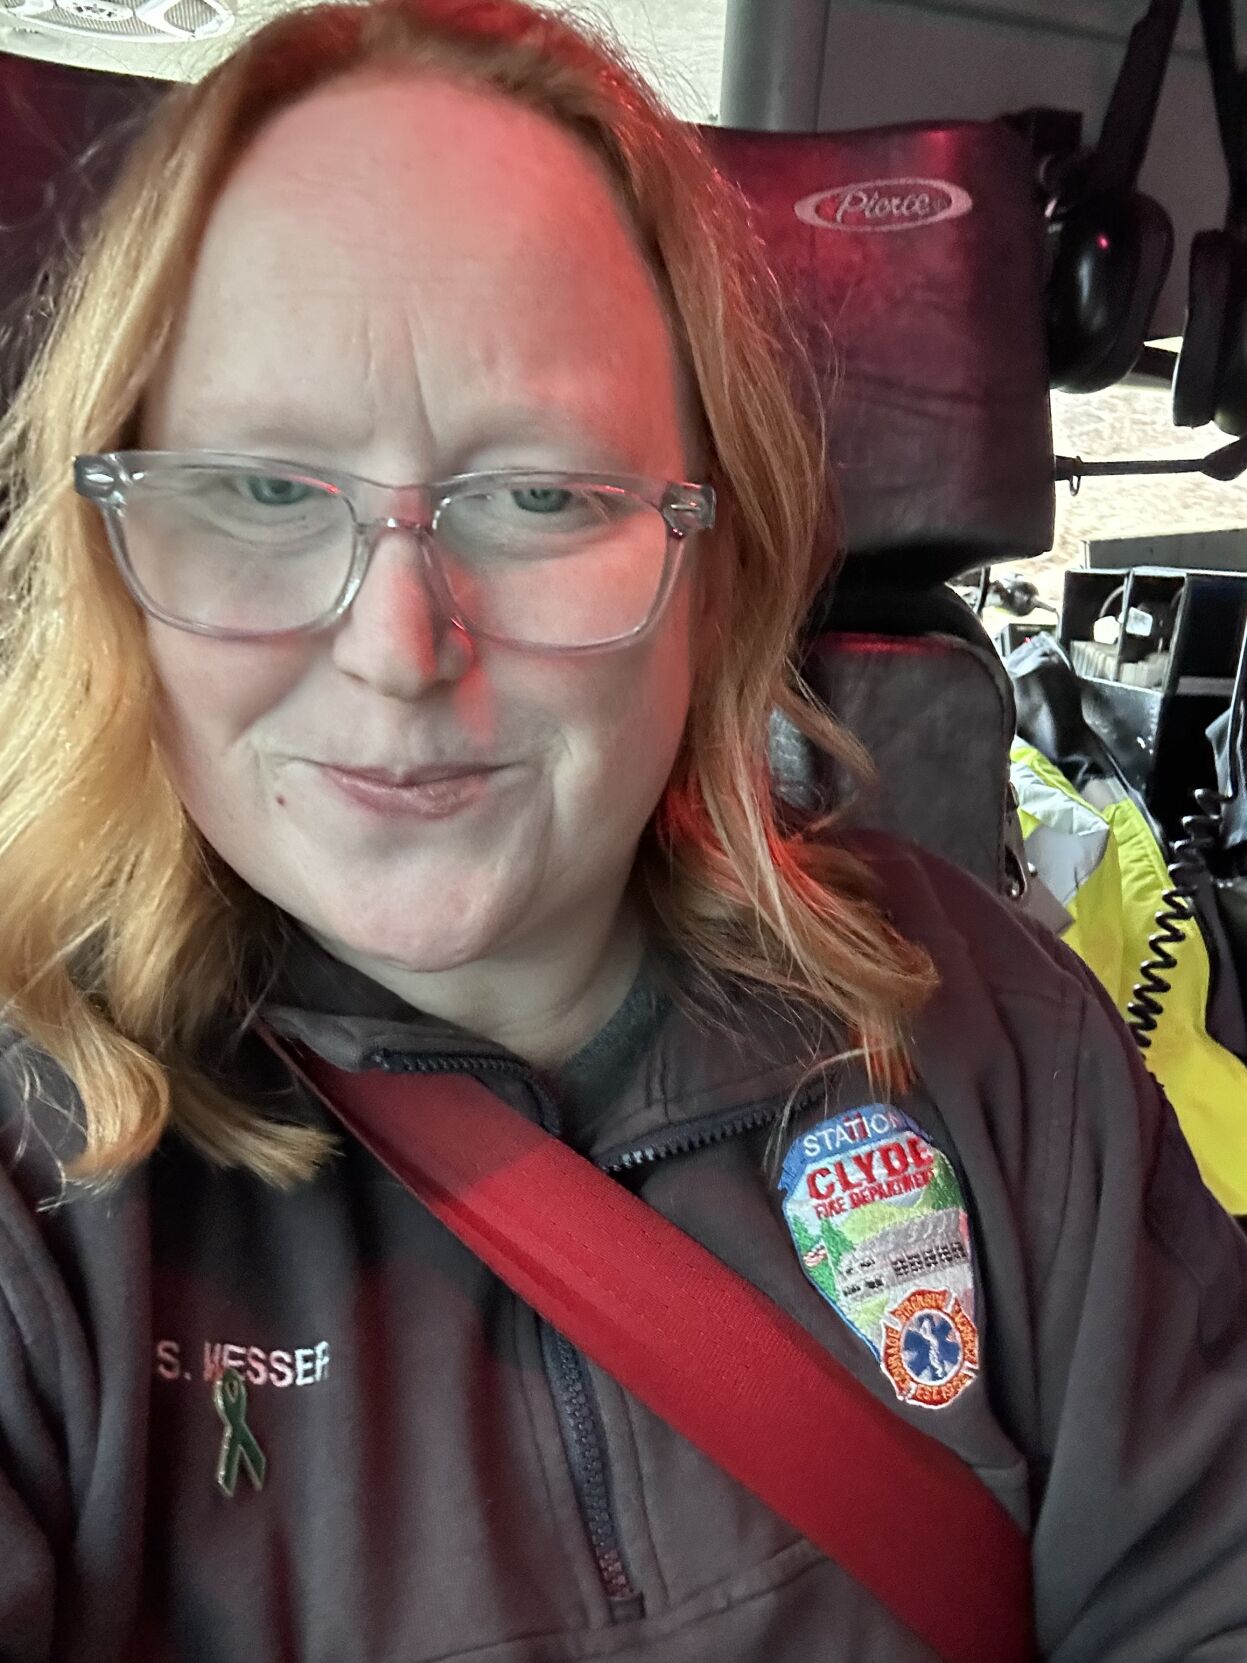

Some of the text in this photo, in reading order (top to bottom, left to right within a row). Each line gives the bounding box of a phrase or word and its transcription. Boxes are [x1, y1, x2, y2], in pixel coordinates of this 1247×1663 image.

[835, 189, 930, 224] Pierce
[813, 1196, 848, 1220] FIRE
[157, 1340, 192, 1381] S.
